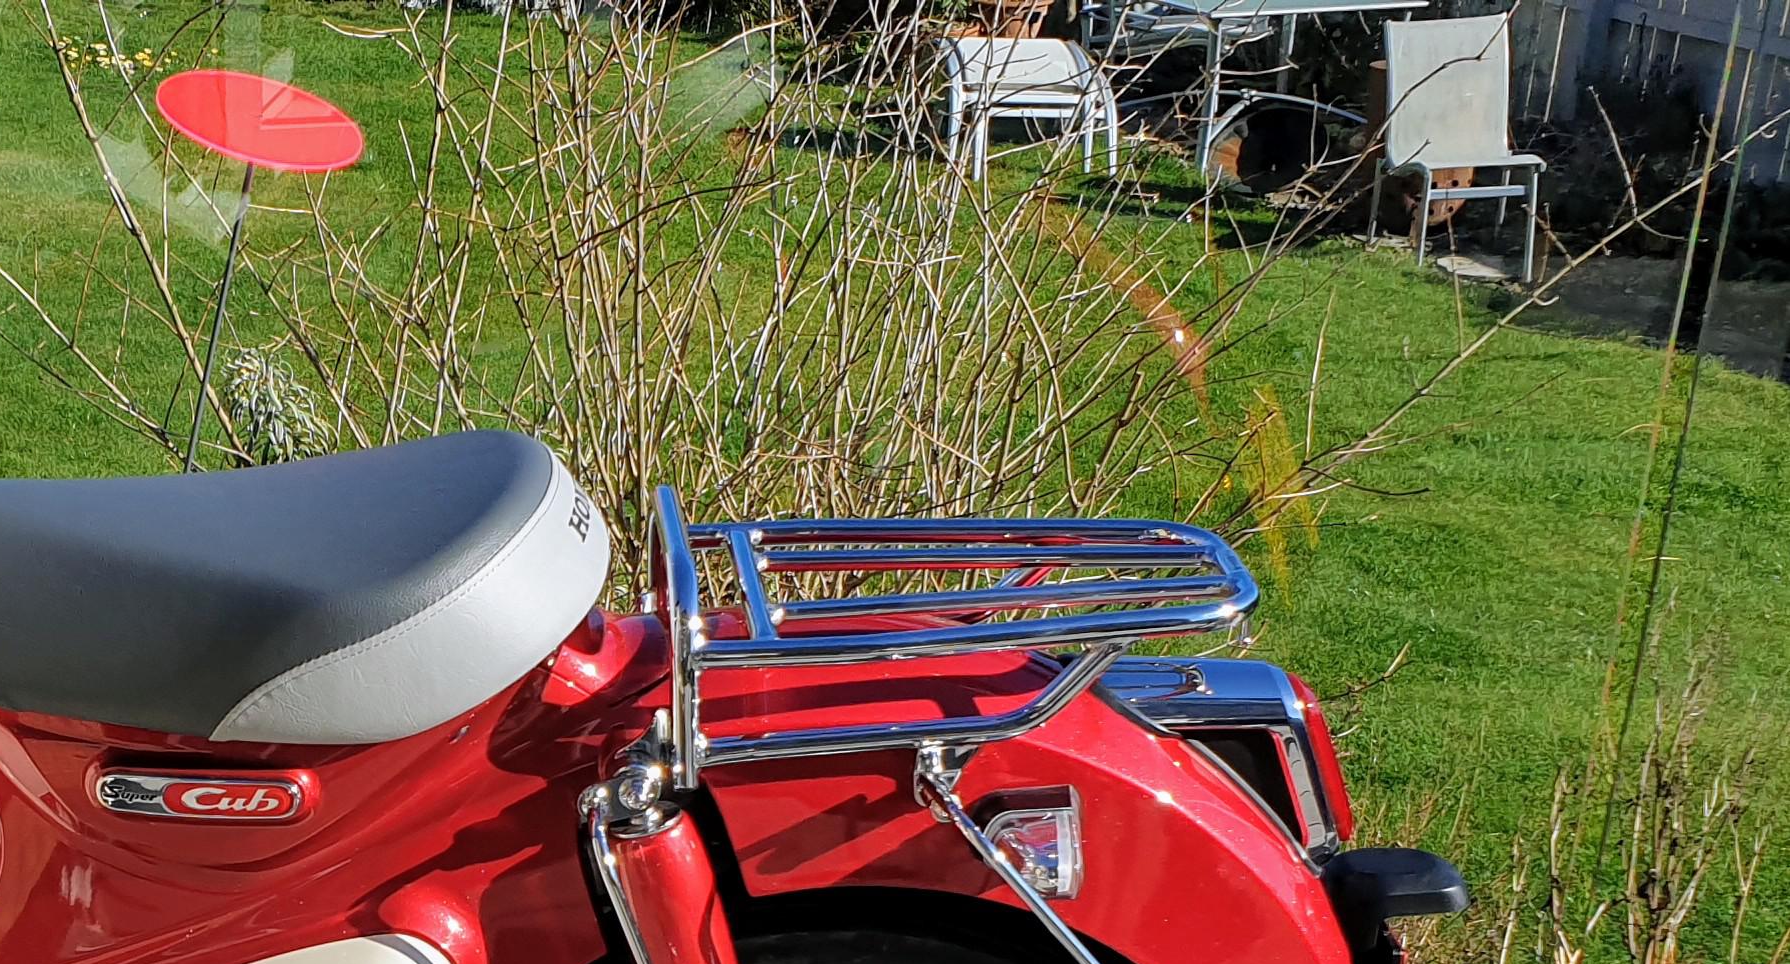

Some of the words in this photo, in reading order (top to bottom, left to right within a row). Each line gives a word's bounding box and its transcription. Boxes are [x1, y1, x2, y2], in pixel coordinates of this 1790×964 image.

[568, 489, 591, 543] HO
[102, 784, 158, 805] Super
[180, 787, 279, 812] Cub
